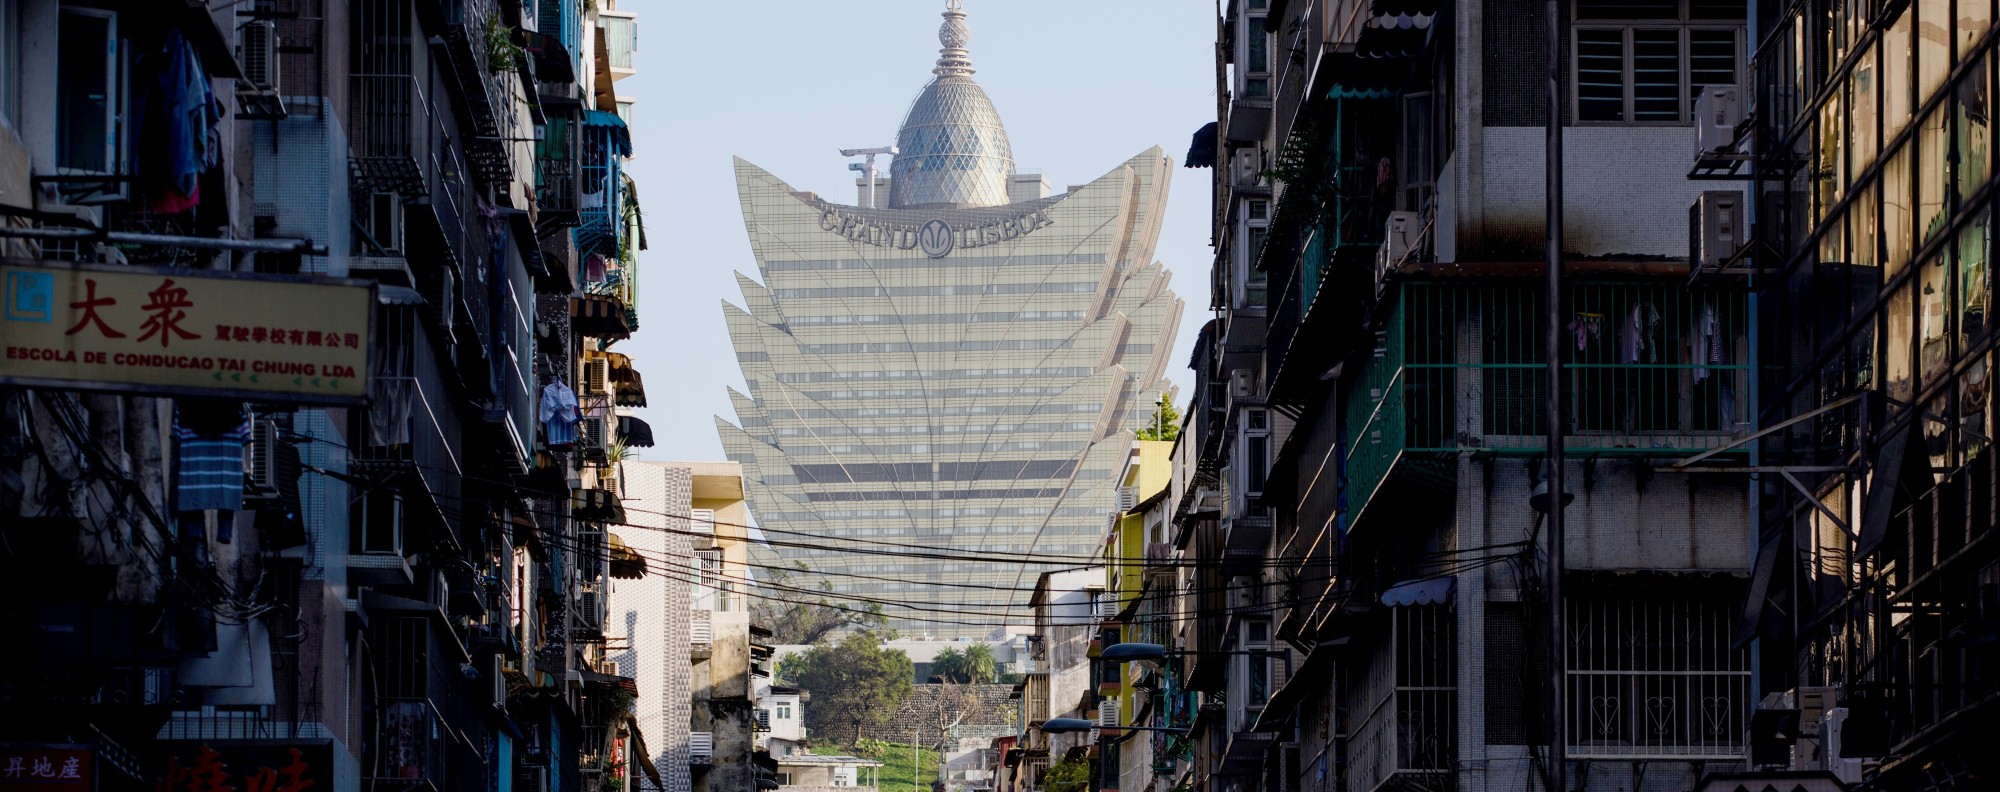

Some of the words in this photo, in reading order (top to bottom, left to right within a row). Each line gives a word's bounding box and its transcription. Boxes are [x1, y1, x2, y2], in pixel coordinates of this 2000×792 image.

[817, 210, 918, 250] GRAND
[959, 206, 1055, 249] LISBOA
[214, 324, 359, 349] 駕駛學校有限公司
[6, 346, 77, 363] ESCOLA
[83, 350, 107, 365] DE
[113, 352, 214, 371] CONDUCAO
[217, 358, 246, 372] TAI
[252, 360, 316, 376] CHUNG
[322, 365, 356, 379] LDA
